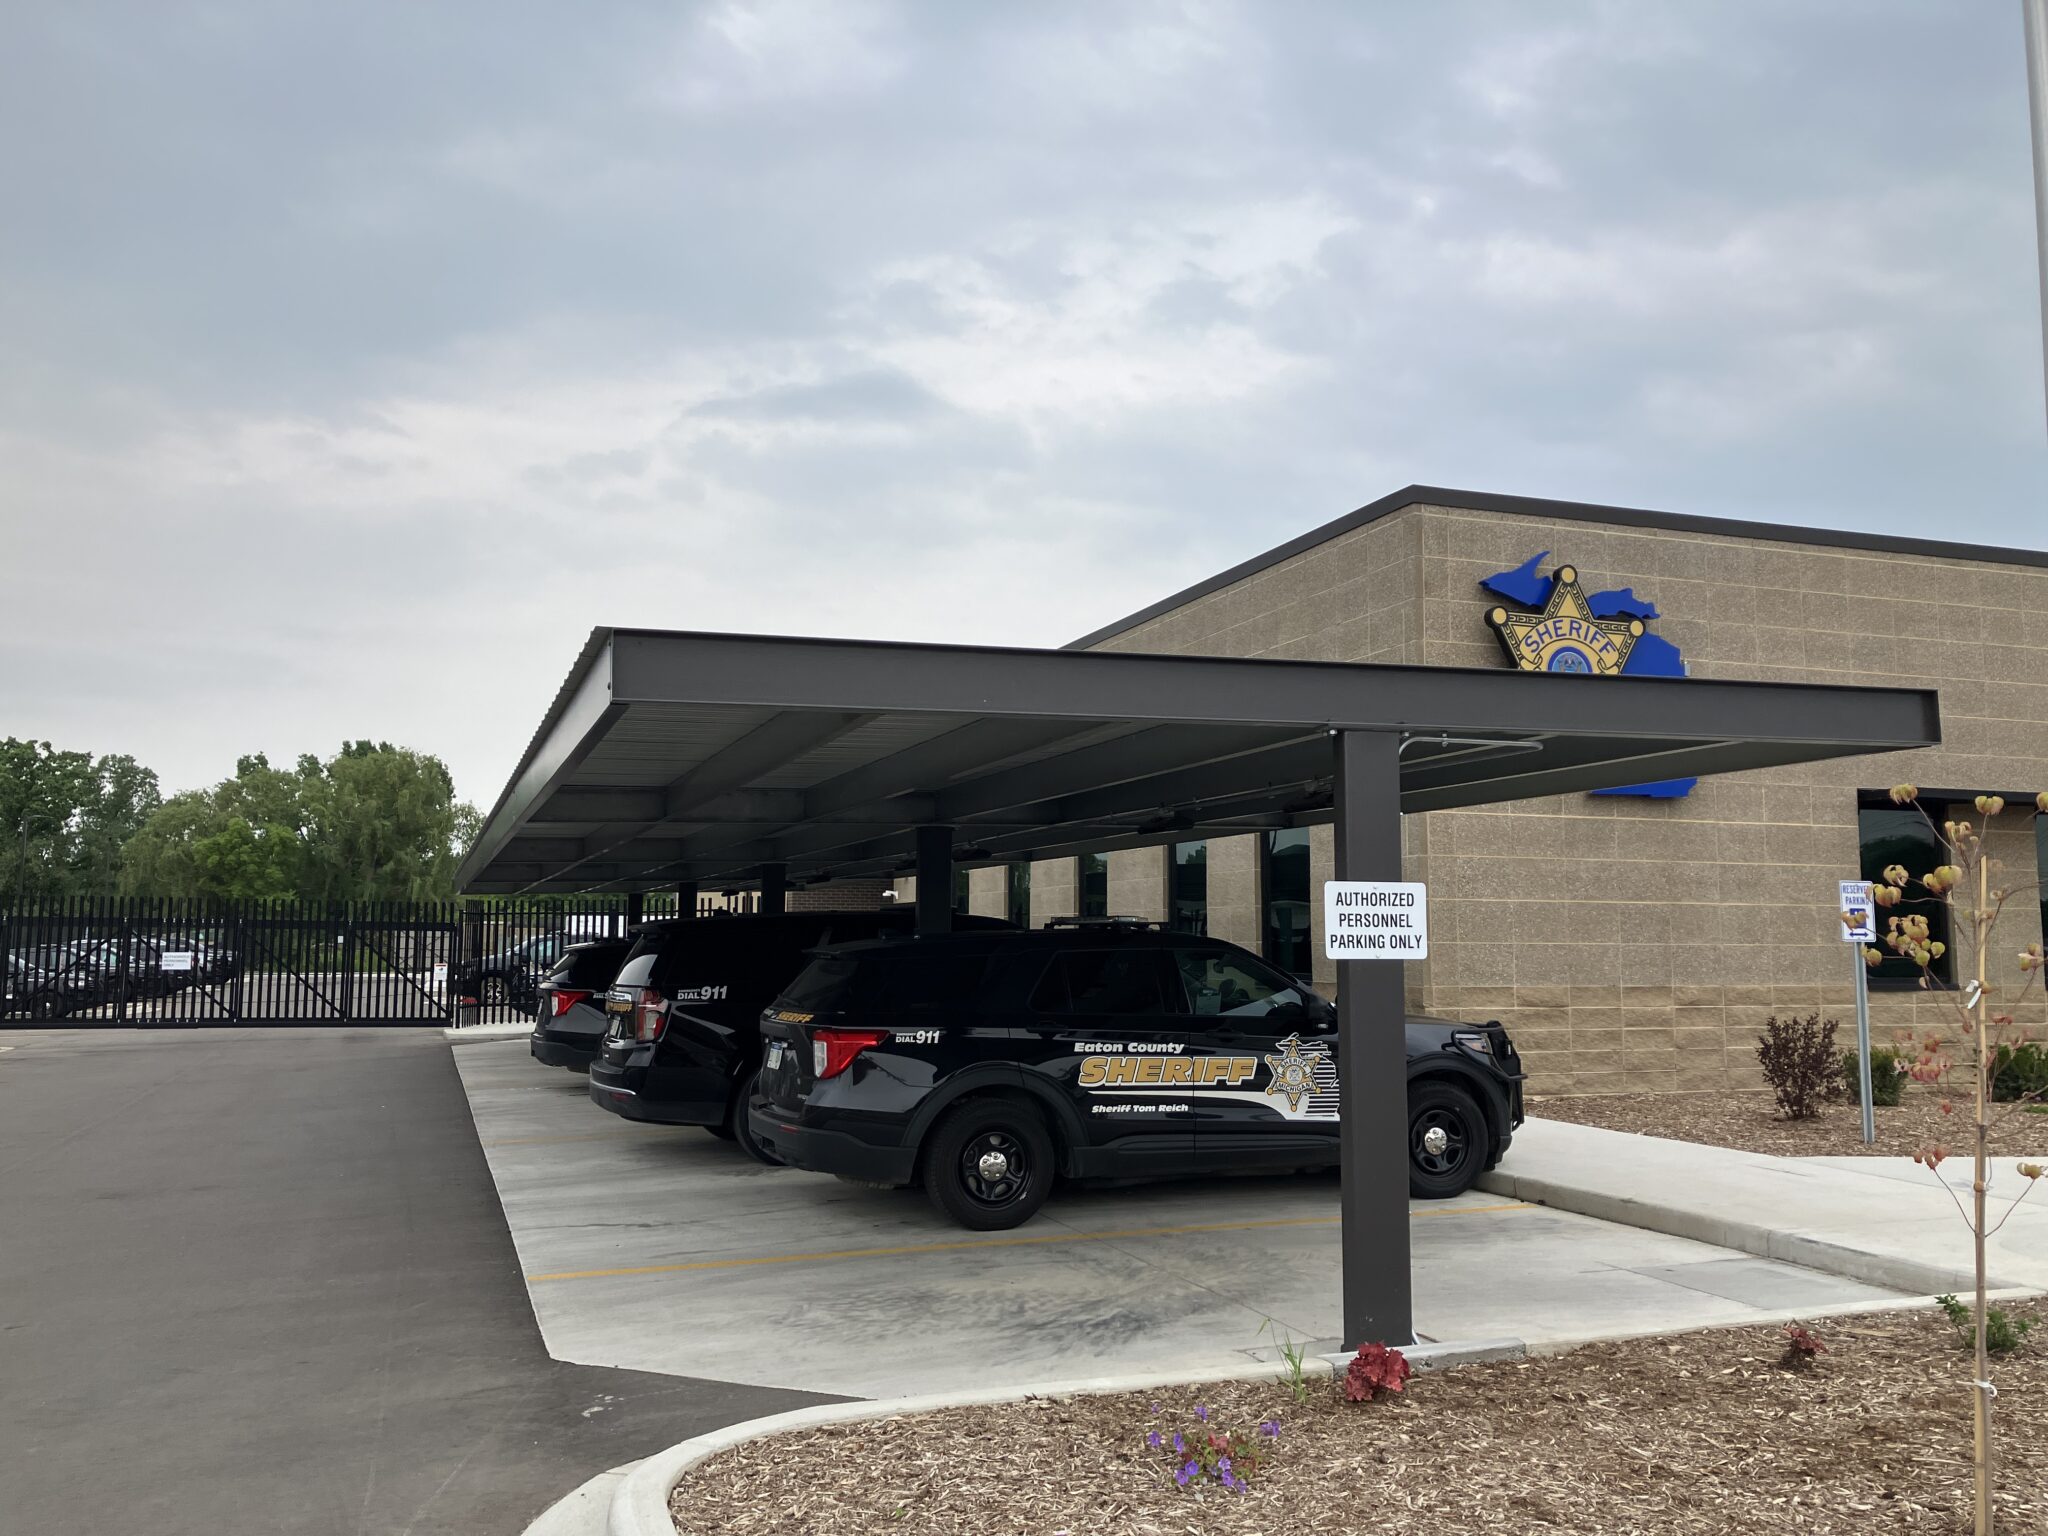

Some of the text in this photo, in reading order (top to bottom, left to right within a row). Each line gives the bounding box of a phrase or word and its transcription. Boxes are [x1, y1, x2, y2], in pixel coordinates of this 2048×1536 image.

[1524, 619, 1617, 655] SHERIFF
[1336, 892, 1415, 906] AUTHORIZED
[1339, 913, 1413, 928] PERSONNEL
[1330, 934, 1422, 949] PARKING ONLY
[677, 985, 728, 1000] DIAL 911
[916, 1030, 940, 1044] 911
[1074, 1042, 1184, 1055] Eaton County
[1280, 1058, 1308, 1068] SHERIFF
[1079, 1056, 1258, 1086] SHERIFF
[1278, 1081, 1313, 1092] MICHIGAN
[1091, 1104, 1189, 1113] Sheriff Tom Reich
